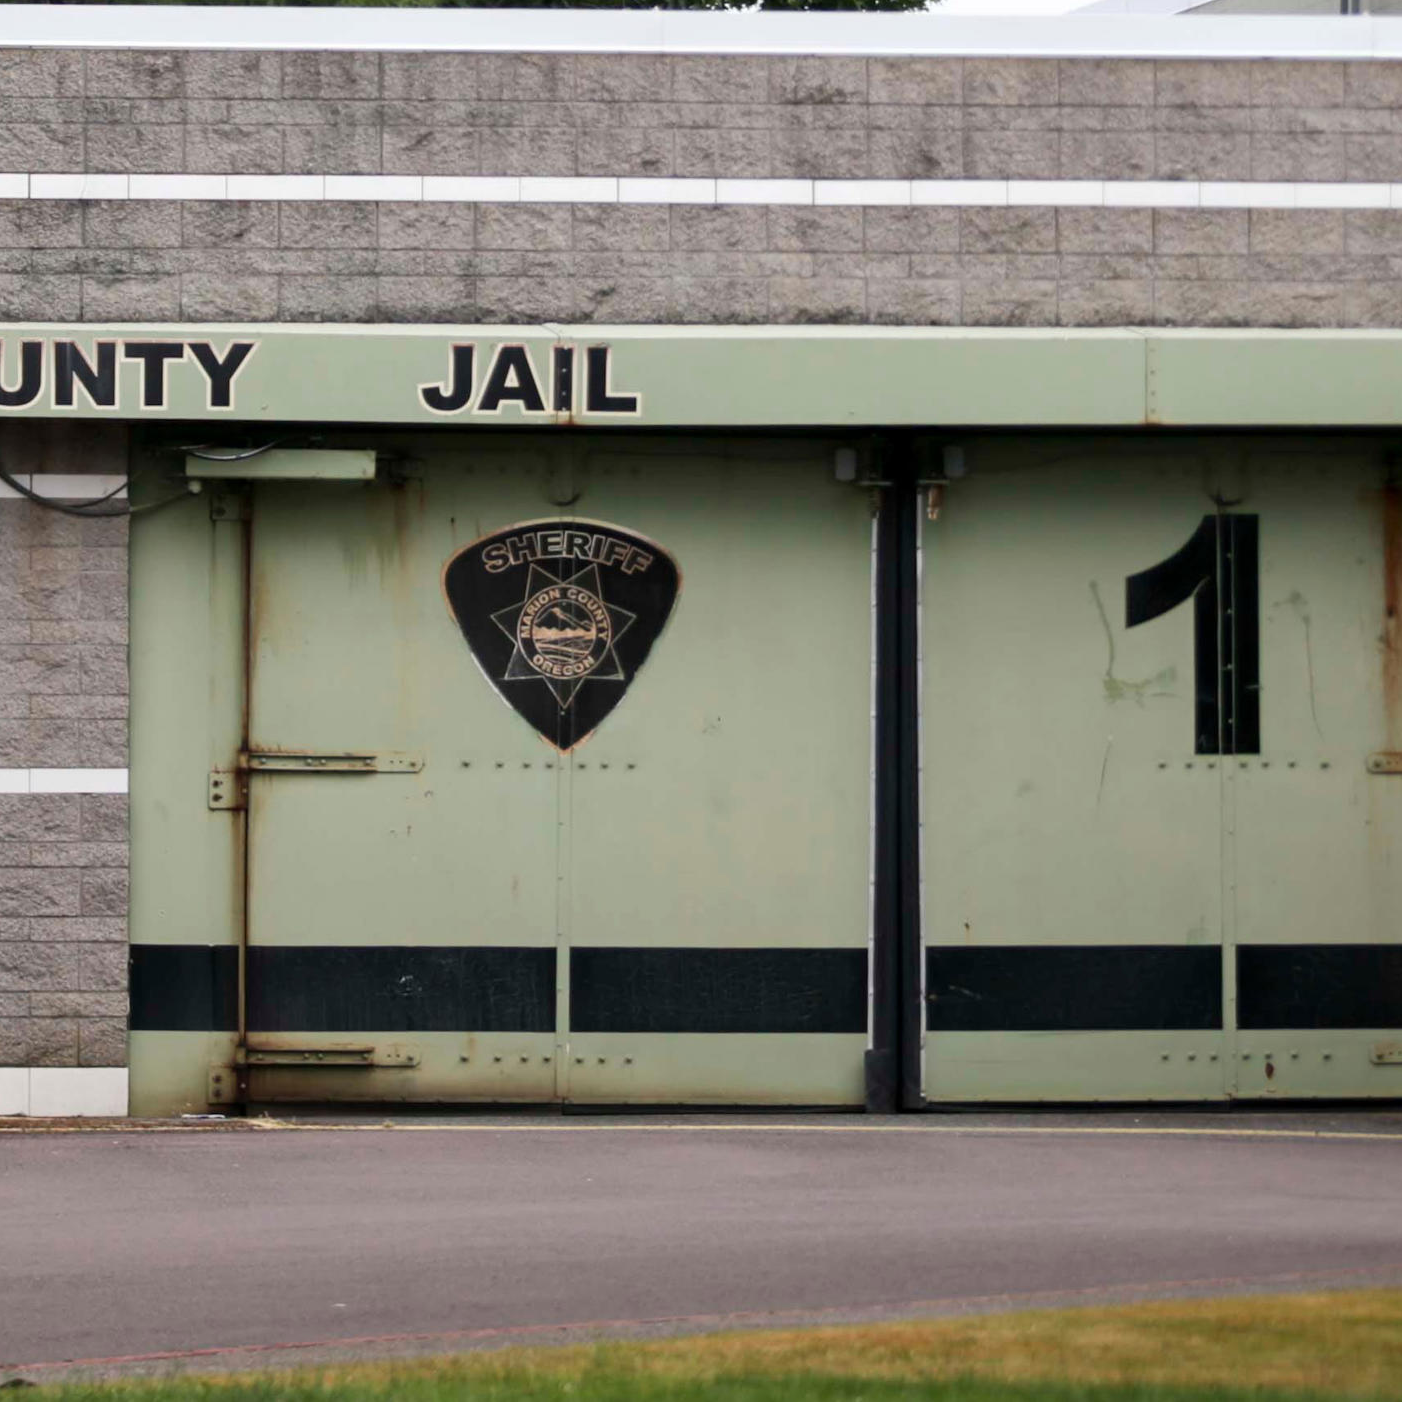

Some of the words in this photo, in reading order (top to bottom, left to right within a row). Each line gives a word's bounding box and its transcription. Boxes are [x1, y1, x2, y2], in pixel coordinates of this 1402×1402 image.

[418, 343, 641, 416] JAIL
[482, 530, 653, 574] SHERIFF
[521, 588, 560, 638] MARION
[567, 588, 608, 640] COUNTY
[1126, 515, 1260, 755] 1
[533, 654, 594, 675] OREGON
